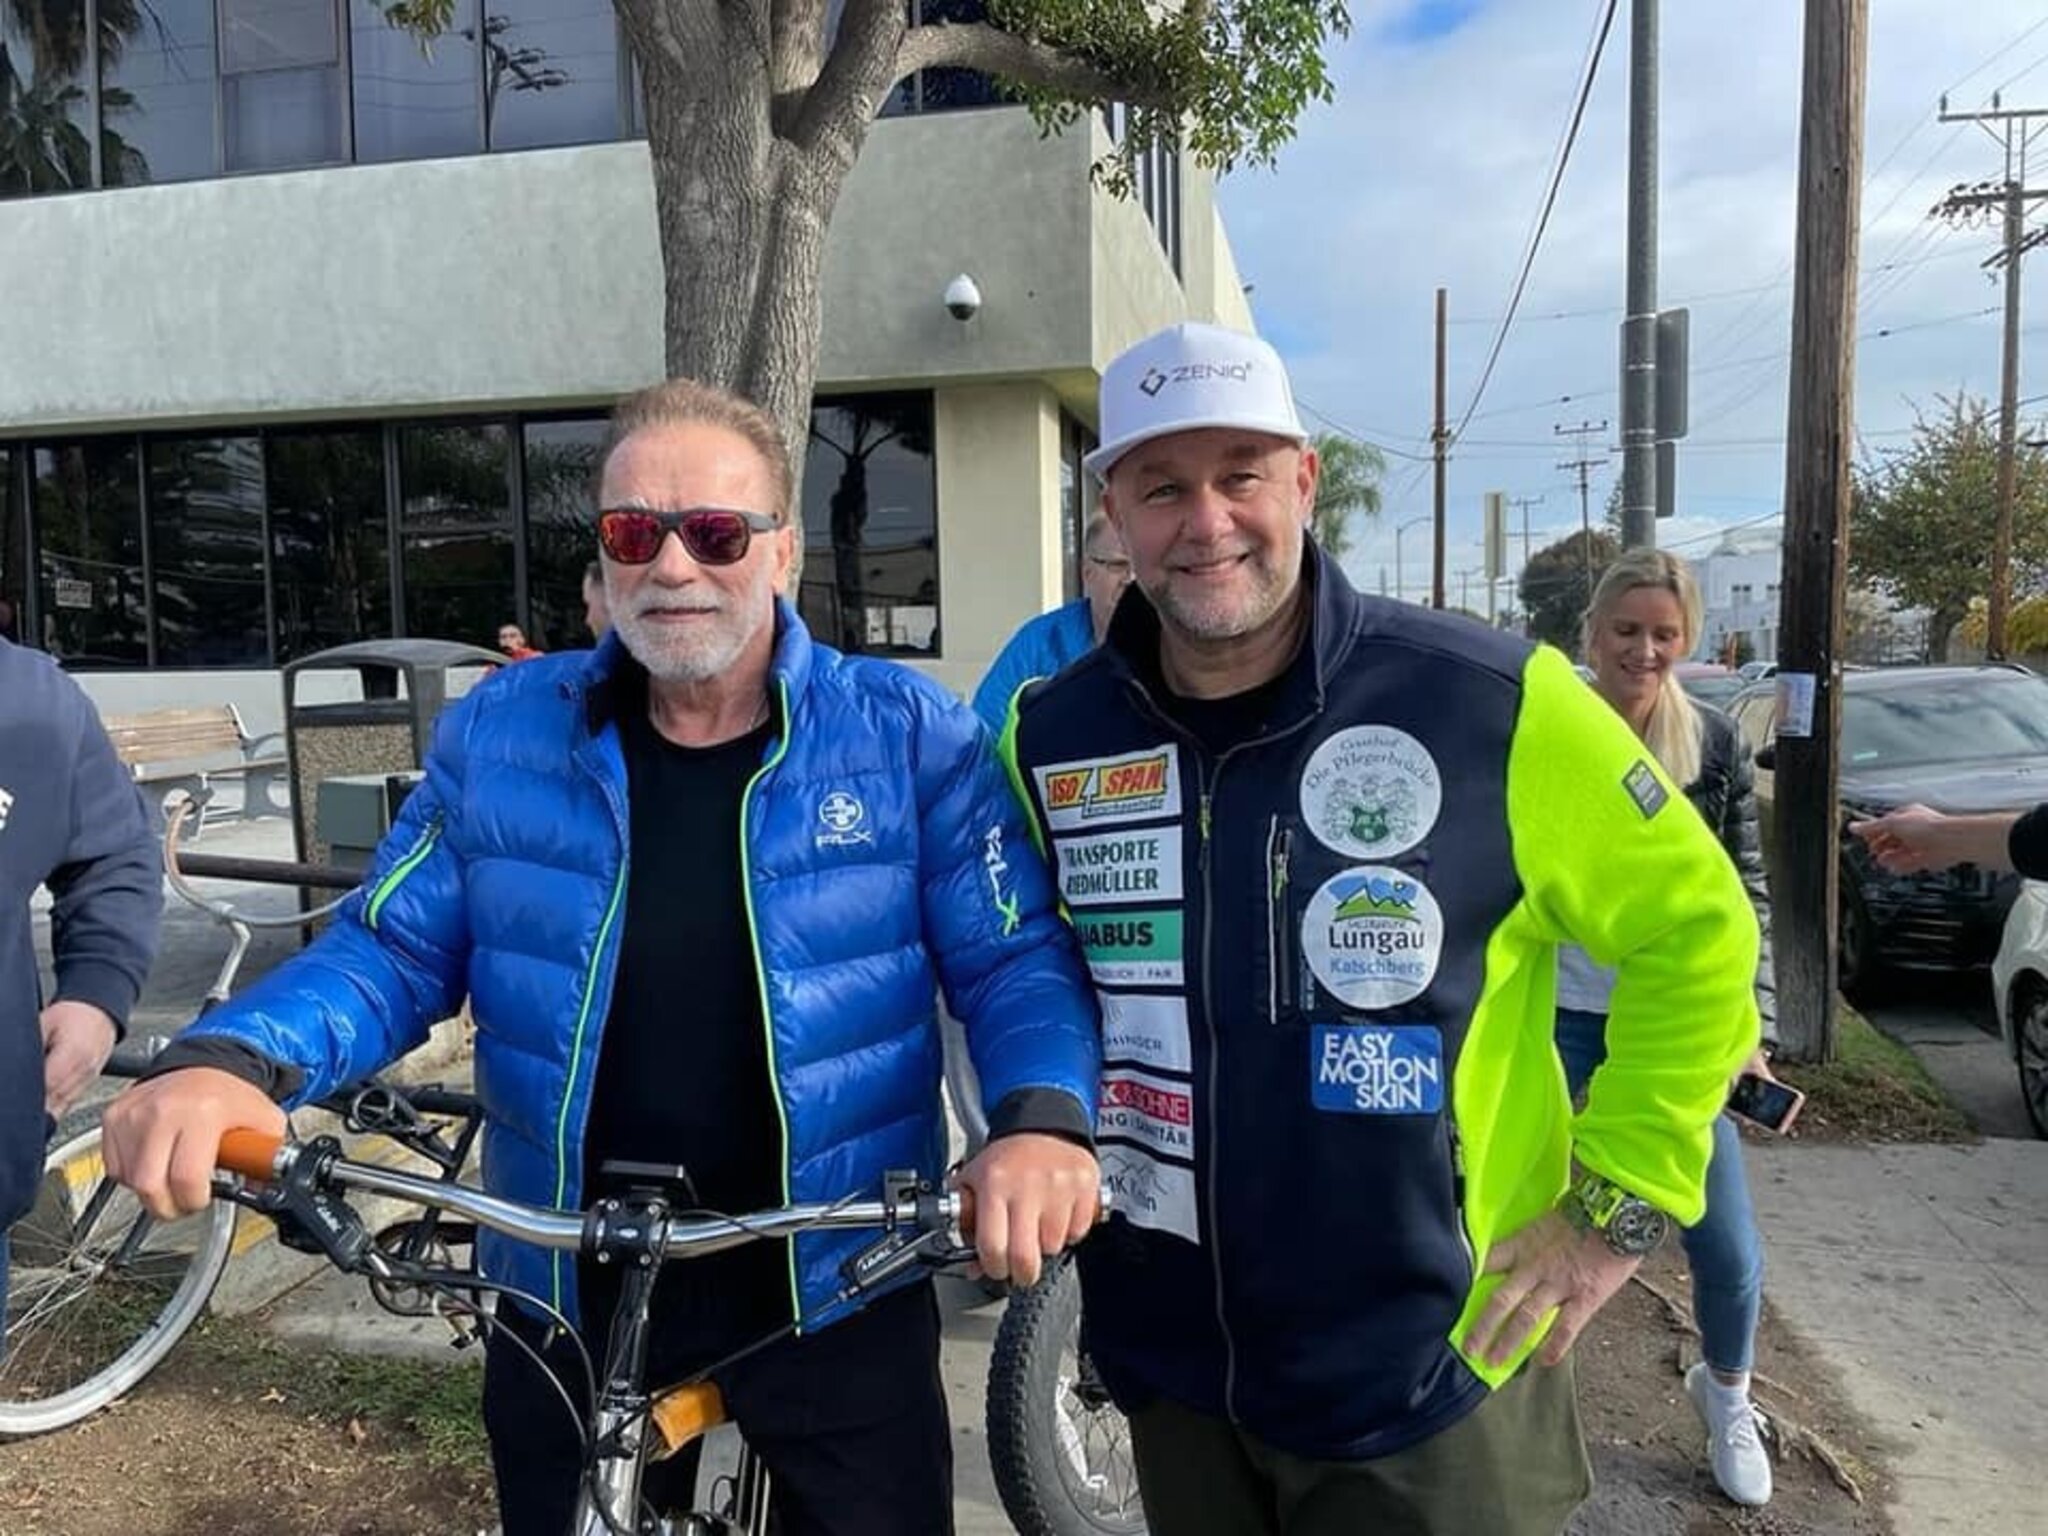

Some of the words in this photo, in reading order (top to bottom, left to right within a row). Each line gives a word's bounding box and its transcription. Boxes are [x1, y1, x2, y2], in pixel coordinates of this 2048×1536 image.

[1053, 777, 1079, 804] ISO
[1105, 763, 1162, 795] SPAN
[1329, 925, 1424, 955] Lungau
[1329, 958, 1426, 980] Katschberg
[1324, 1032, 1395, 1059] EASY
[1319, 1055, 1438, 1084] MOTION
[1355, 1082, 1422, 1110] SKIN
